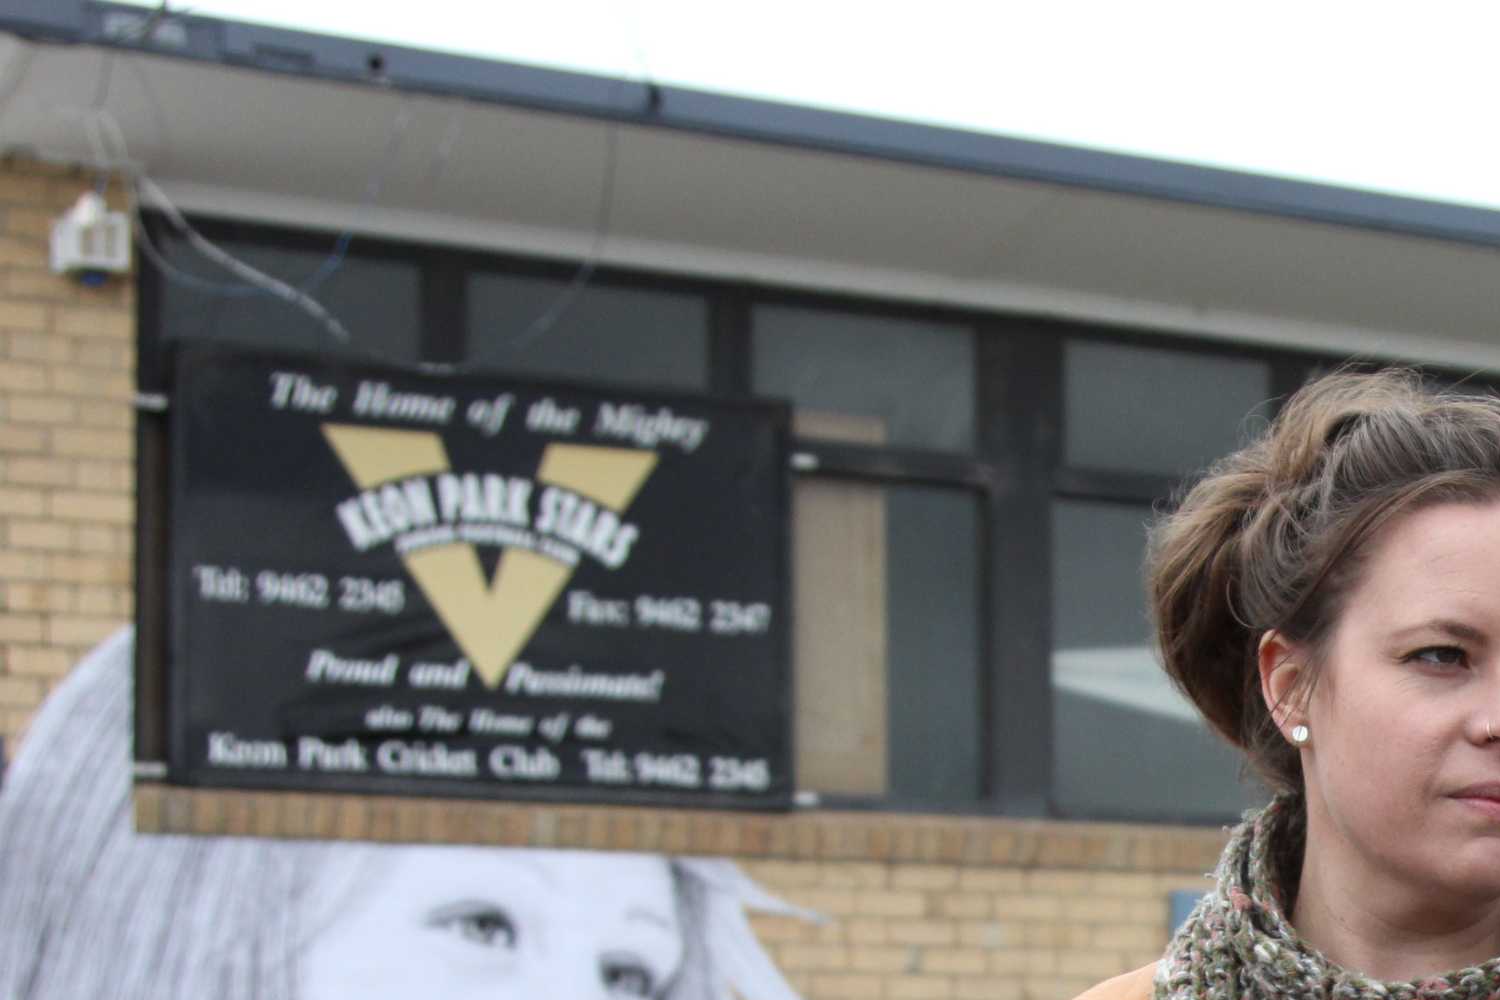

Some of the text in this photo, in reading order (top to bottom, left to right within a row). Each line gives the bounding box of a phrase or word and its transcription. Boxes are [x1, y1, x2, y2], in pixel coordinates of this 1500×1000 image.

[271, 372, 708, 452] The Home of the Mighty
[336, 479, 436, 551] KEON
[437, 473, 533, 523] PARK
[536, 486, 639, 568] STARS
[305, 648, 399, 686] Proud
[407, 656, 470, 689] and
[364, 705, 413, 729] also
[538, 713, 569, 739] of
[538, 713, 570, 743] Home
[207, 731, 288, 768] Keon
[297, 736, 368, 772] Park
[376, 740, 478, 777] Cricket
[488, 745, 561, 779] Club
